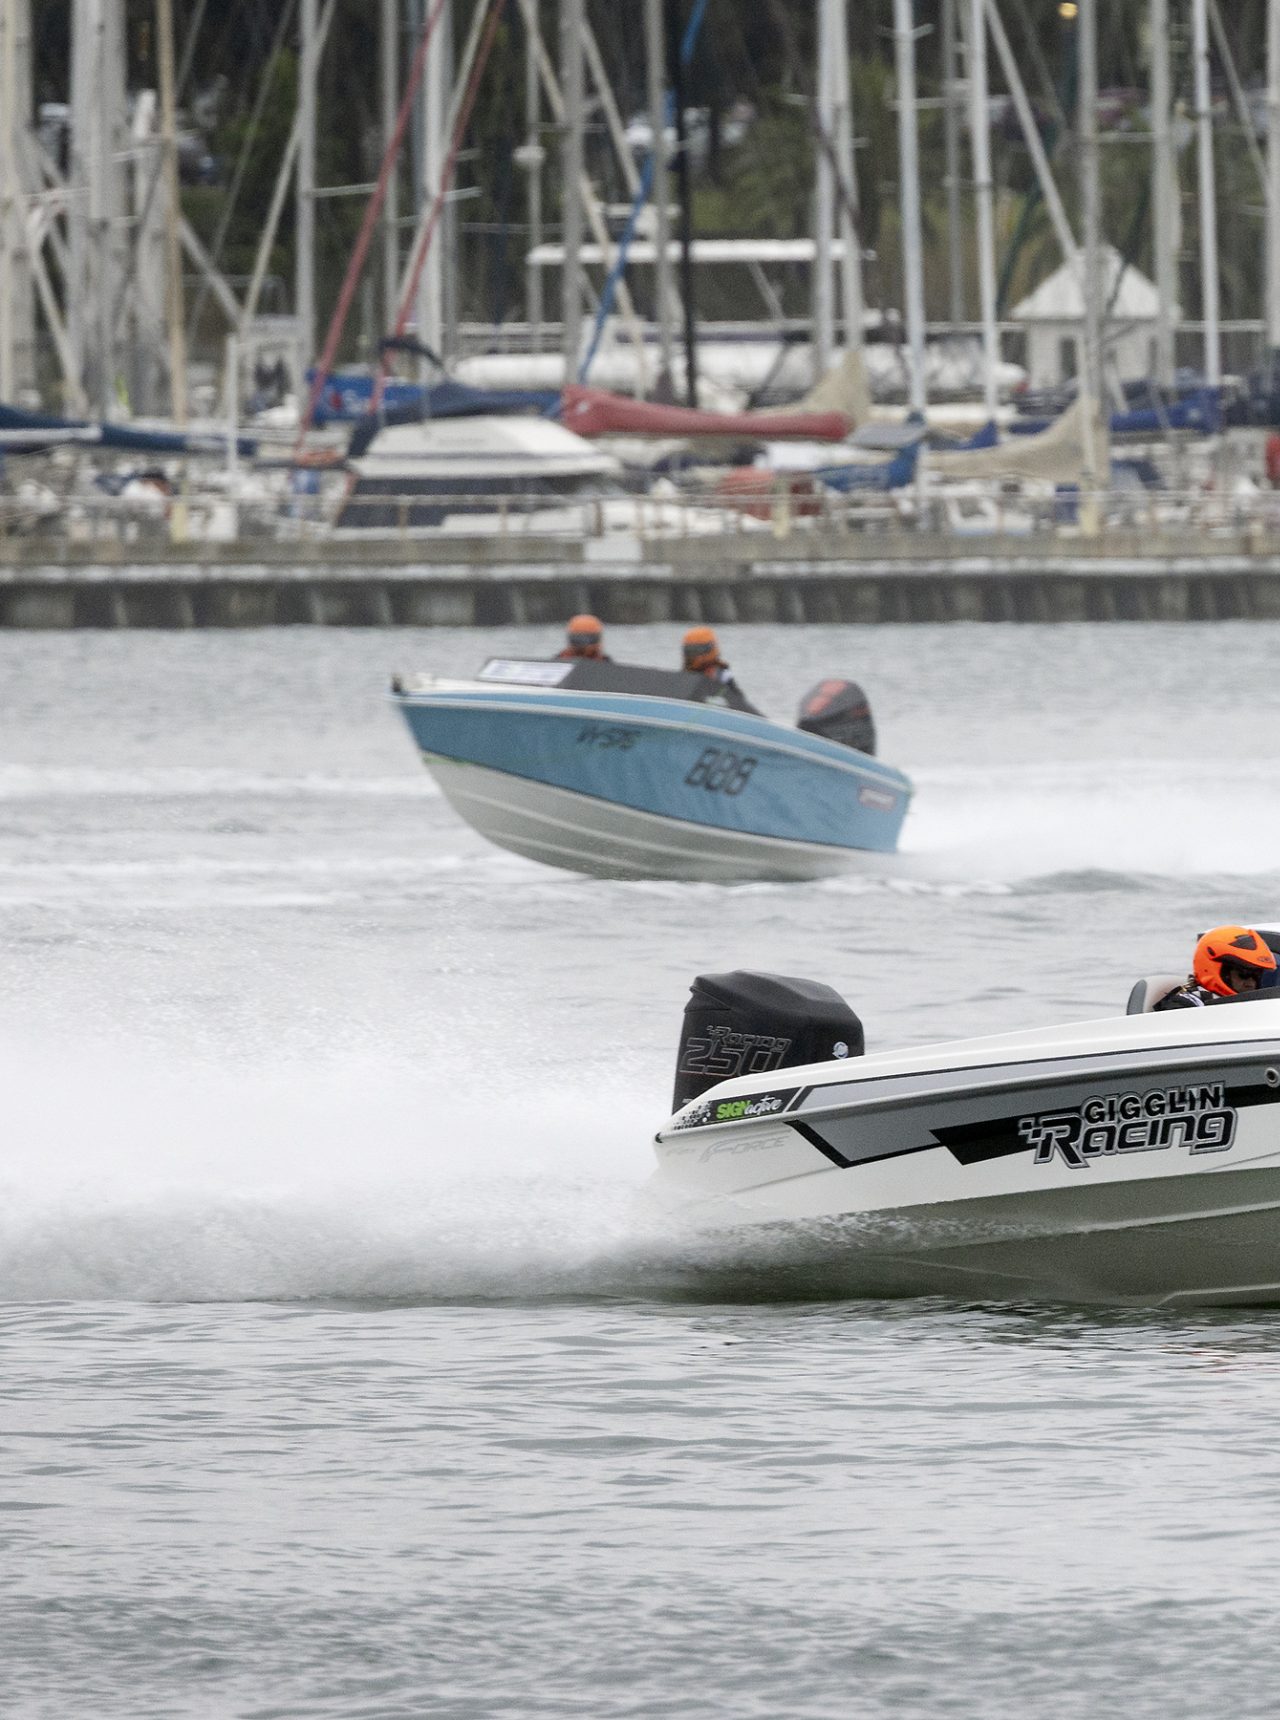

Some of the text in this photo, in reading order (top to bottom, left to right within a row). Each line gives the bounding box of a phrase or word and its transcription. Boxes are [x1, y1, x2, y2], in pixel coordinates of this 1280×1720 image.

[679, 1037, 789, 1077] 250
[707, 1025, 792, 1053] Racing
[1084, 1082, 1225, 1125] GIGGLIN
[1020, 1105, 1238, 1168] Racing
